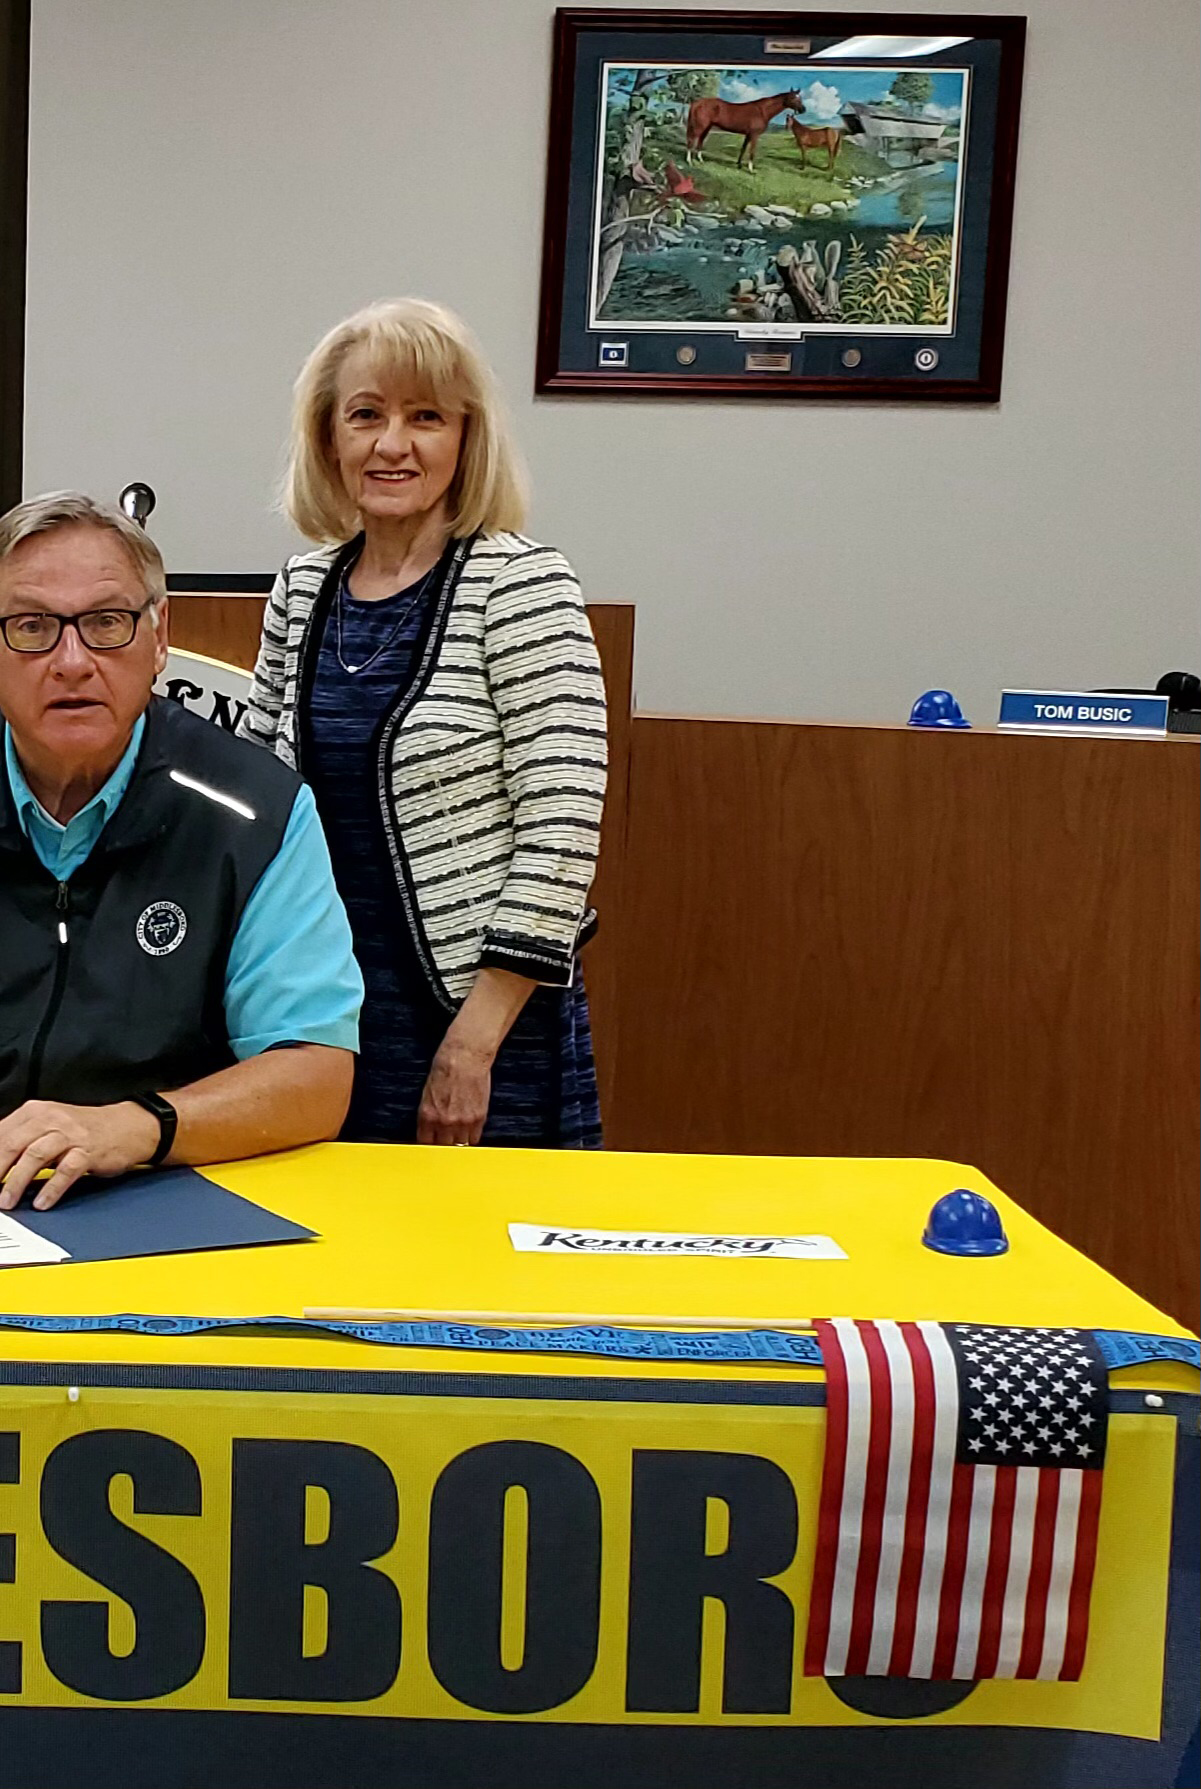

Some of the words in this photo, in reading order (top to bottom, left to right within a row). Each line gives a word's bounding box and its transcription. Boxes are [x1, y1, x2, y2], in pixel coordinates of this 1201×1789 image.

[1034, 704, 1073, 719] TOM
[1077, 706, 1133, 722] BUSIC
[538, 1232, 775, 1253] Kentucky
